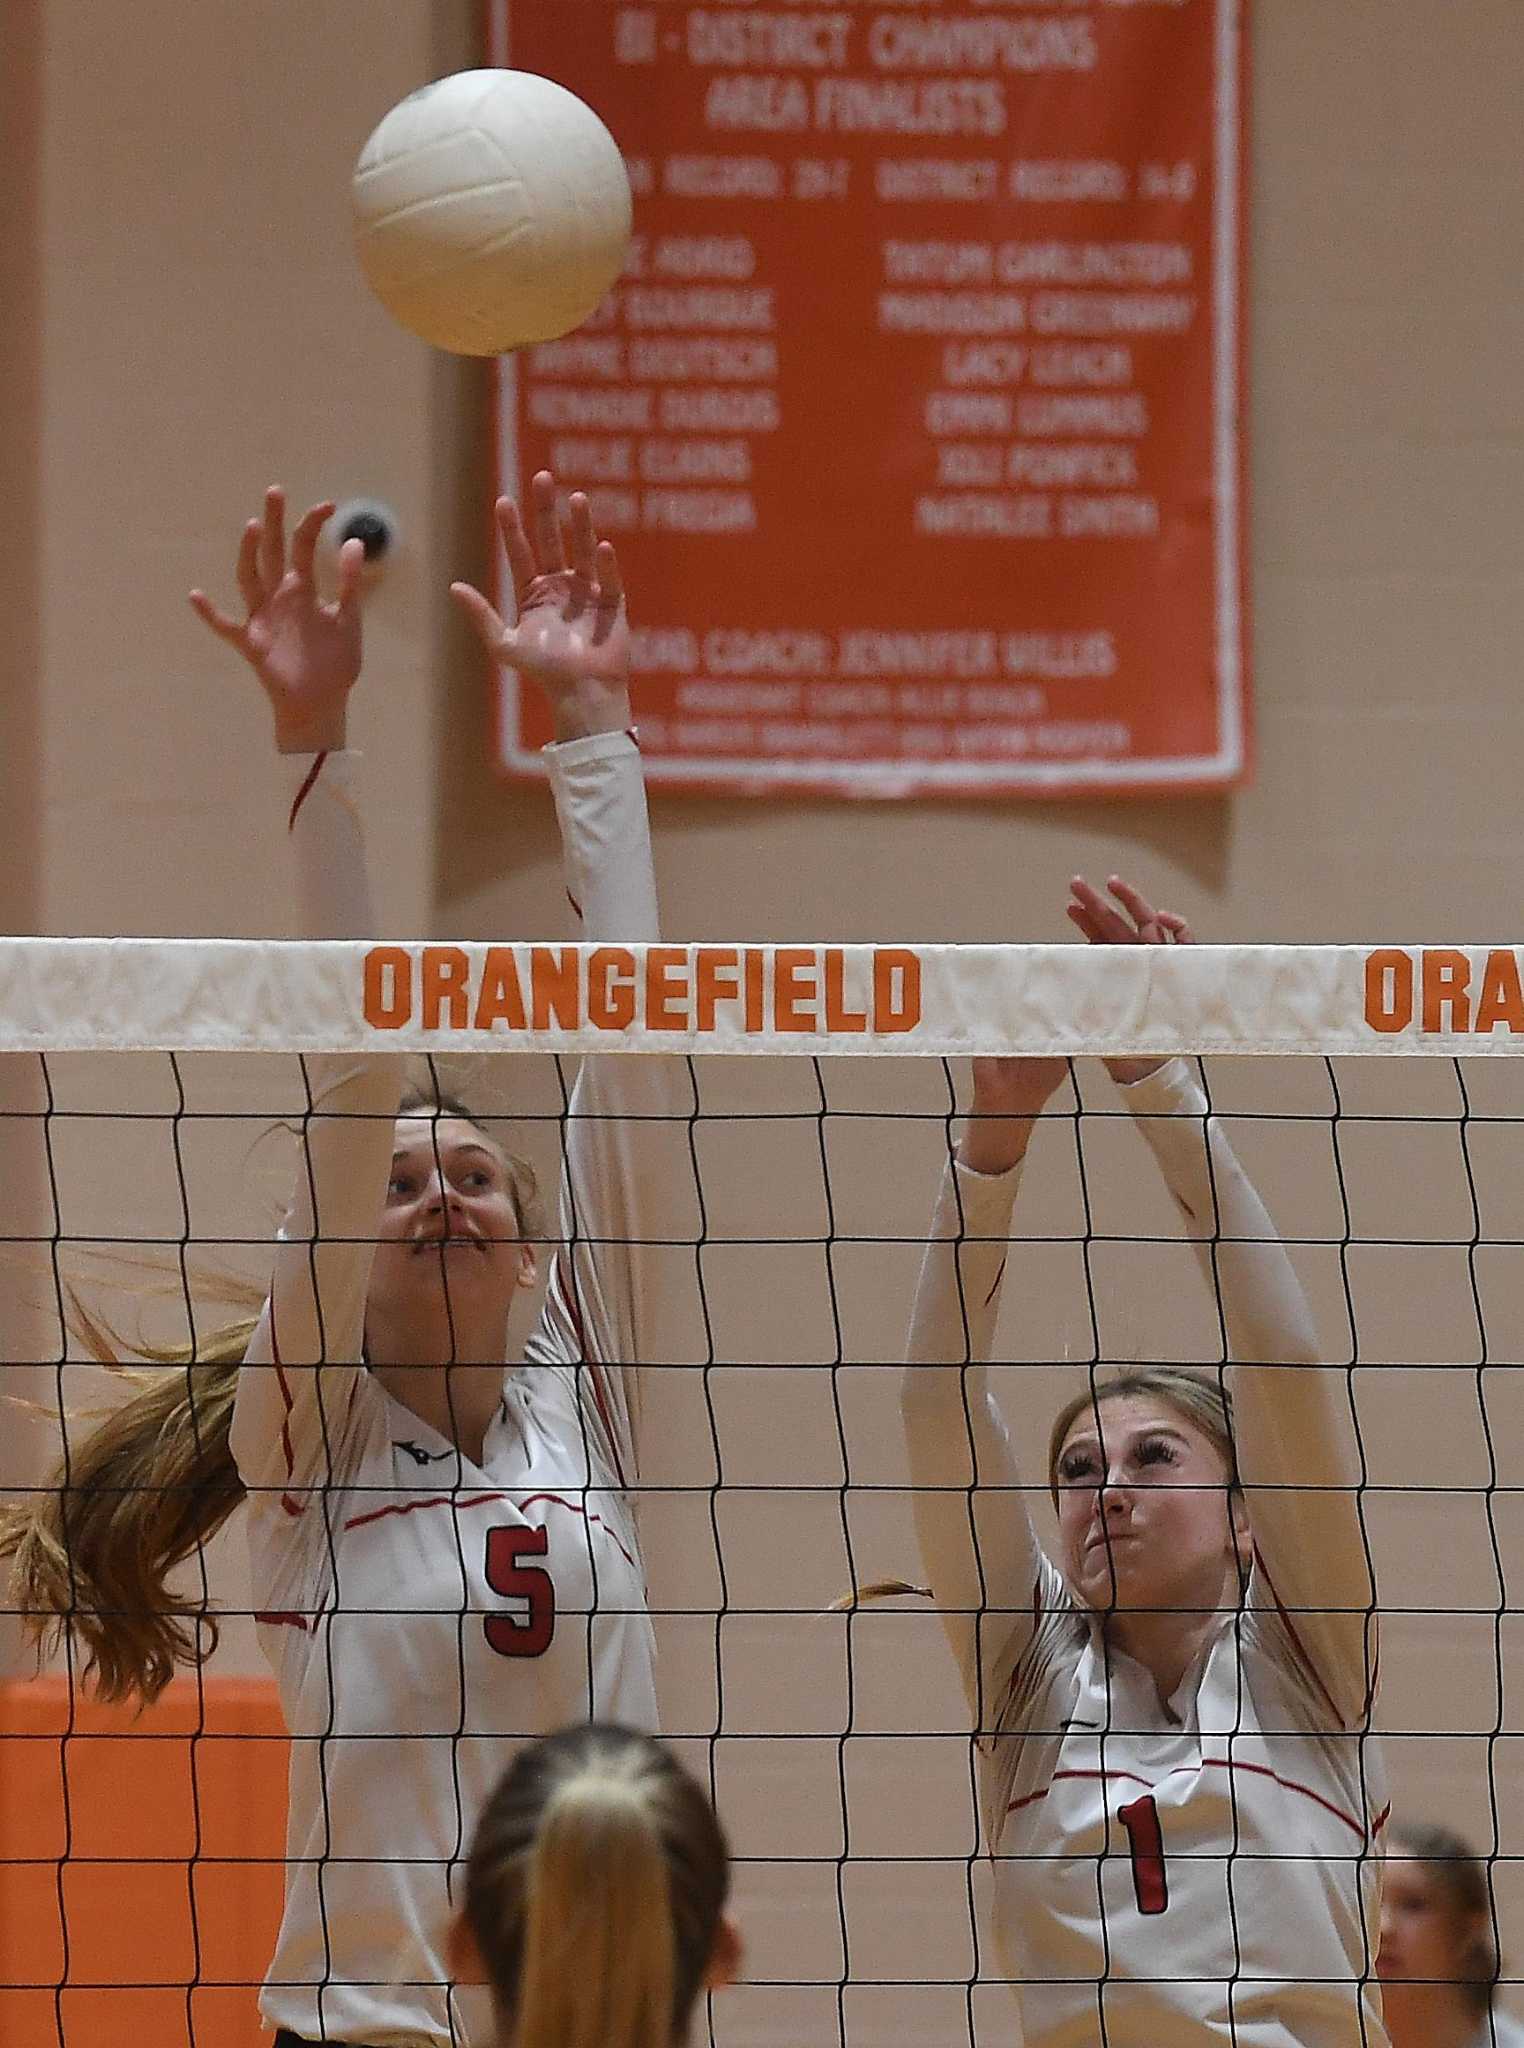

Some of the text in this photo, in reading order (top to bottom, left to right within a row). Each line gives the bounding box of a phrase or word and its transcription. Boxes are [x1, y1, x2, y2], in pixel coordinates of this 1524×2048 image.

[687, 11, 851, 67] DISTRICT
[871, 16, 1097, 71] CHAMPIONS
[706, 76, 1007, 135] AREA FINALISTS
[363, 947, 921, 1033] ORANGEFIELD
[1364, 949, 1524, 1033] ORA
[483, 1524, 556, 1658] 5
[1117, 1794, 1169, 1915] 1
